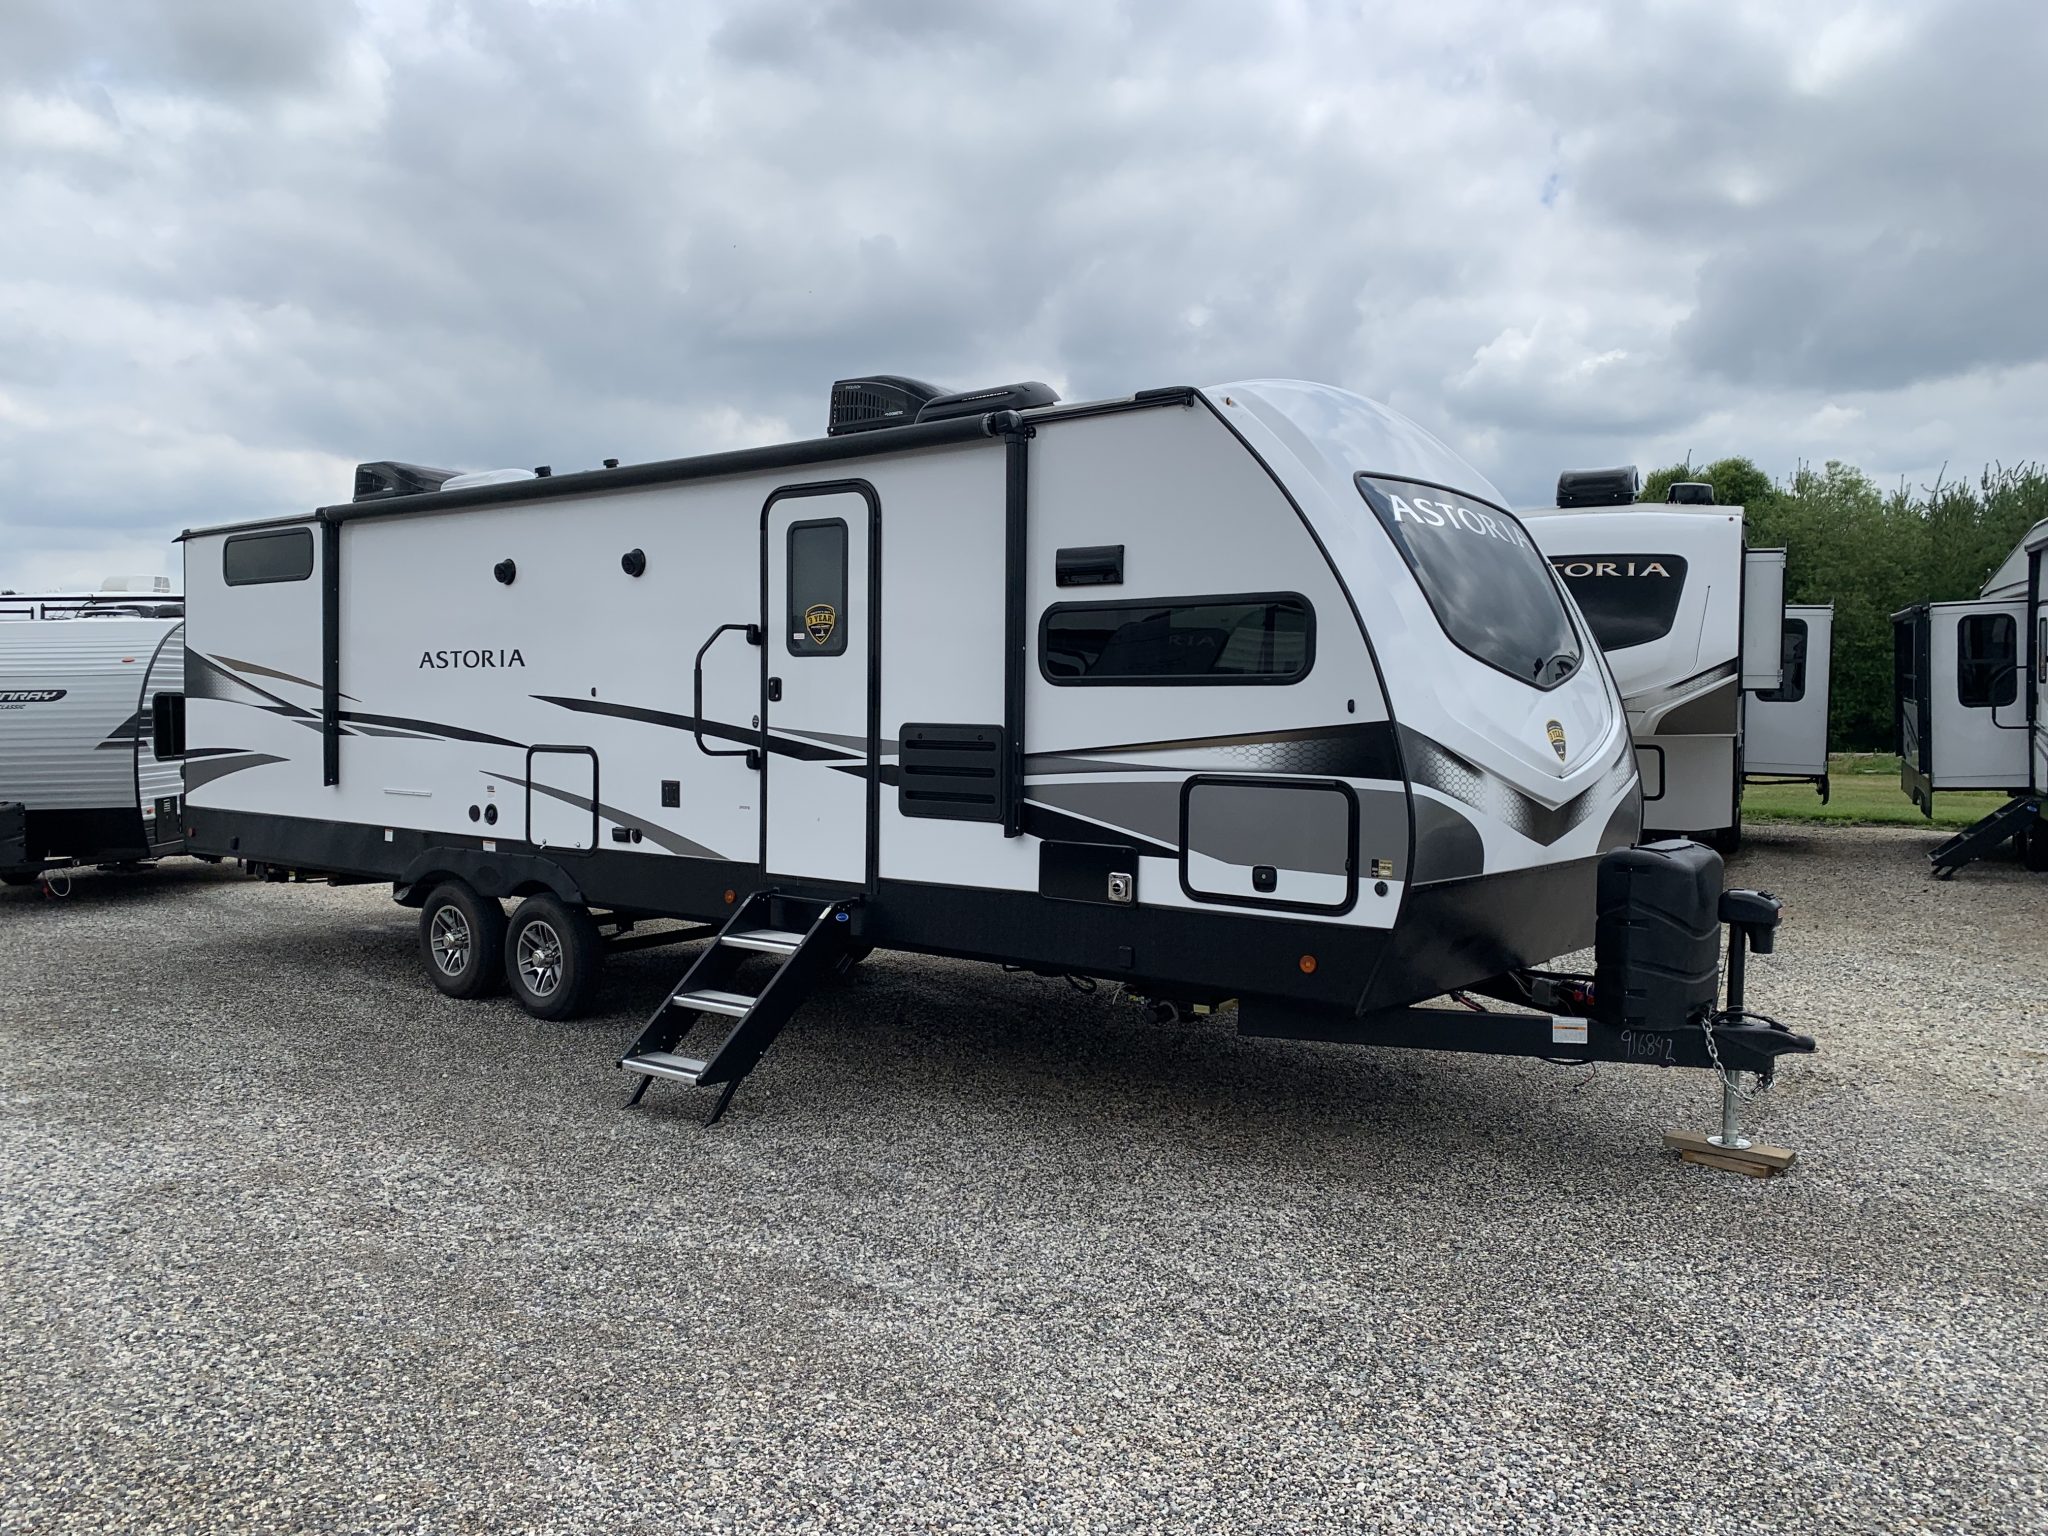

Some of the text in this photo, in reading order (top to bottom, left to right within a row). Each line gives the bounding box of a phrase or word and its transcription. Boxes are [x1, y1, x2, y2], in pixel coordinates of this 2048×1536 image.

[1389, 494, 1537, 554] ASTORIA
[815, 614, 832, 623] YEAR
[418, 649, 526, 669] ASTORIA
[0, 691, 58, 701] NRAY
[1620, 1029, 1677, 1062] 916842
